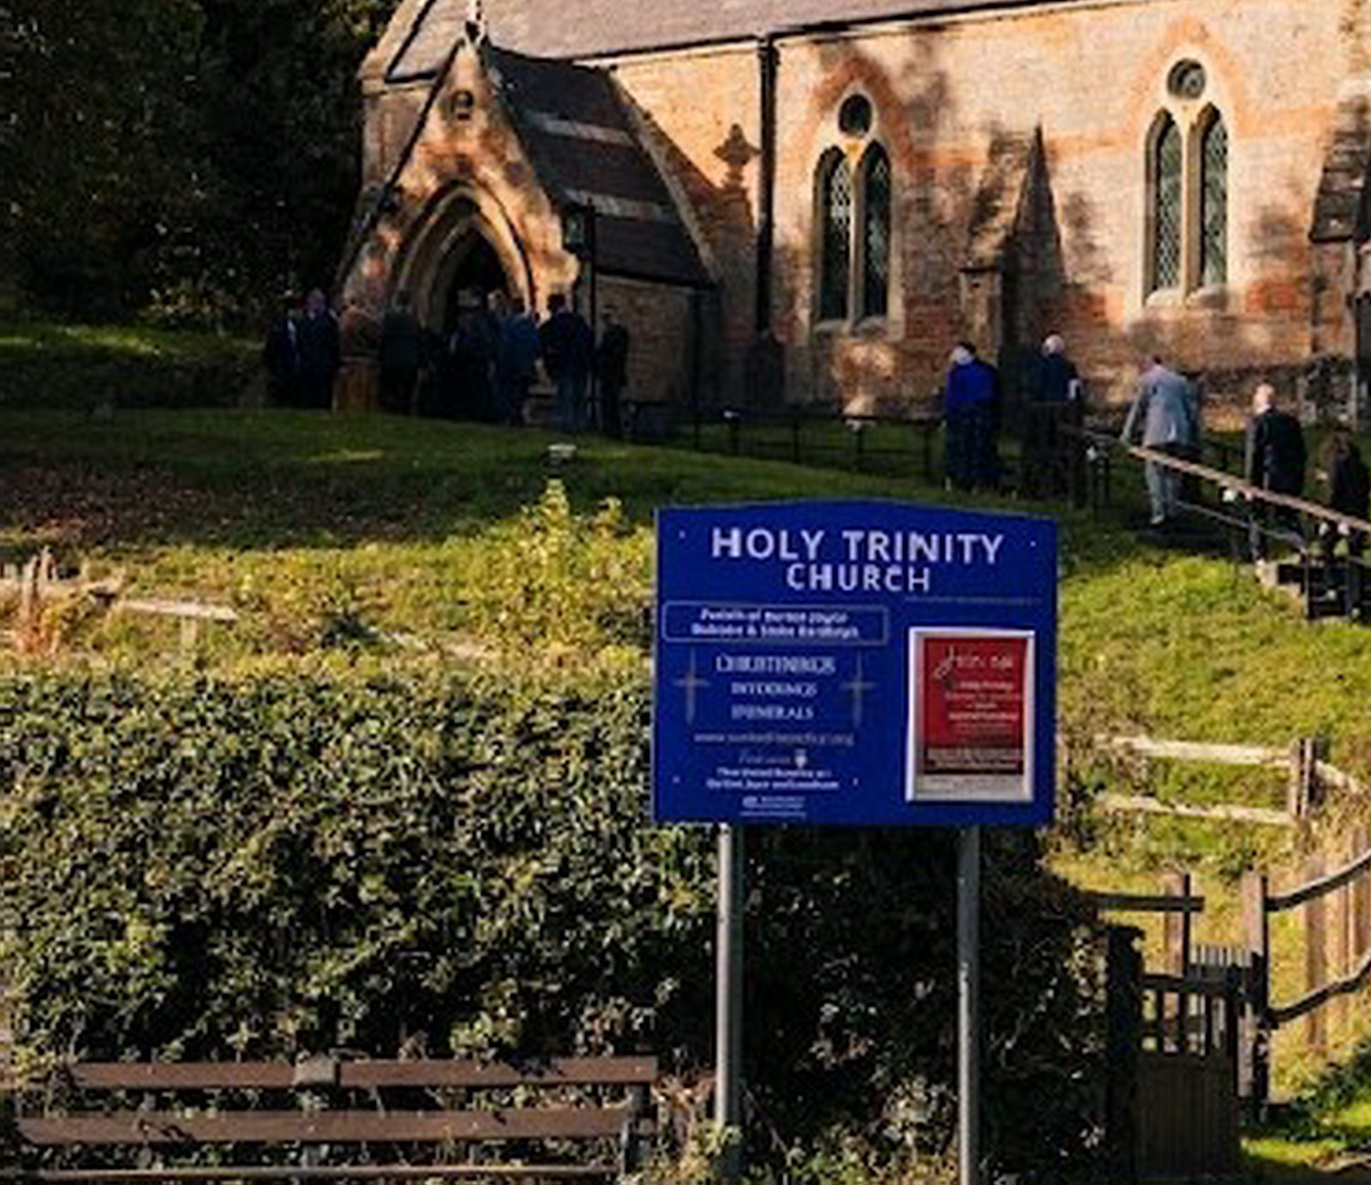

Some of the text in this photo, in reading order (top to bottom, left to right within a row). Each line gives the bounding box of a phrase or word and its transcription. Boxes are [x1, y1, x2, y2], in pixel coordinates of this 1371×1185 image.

[712, 527, 1004, 564] HOLY TRINITY
[786, 563, 930, 592] CHURCH
